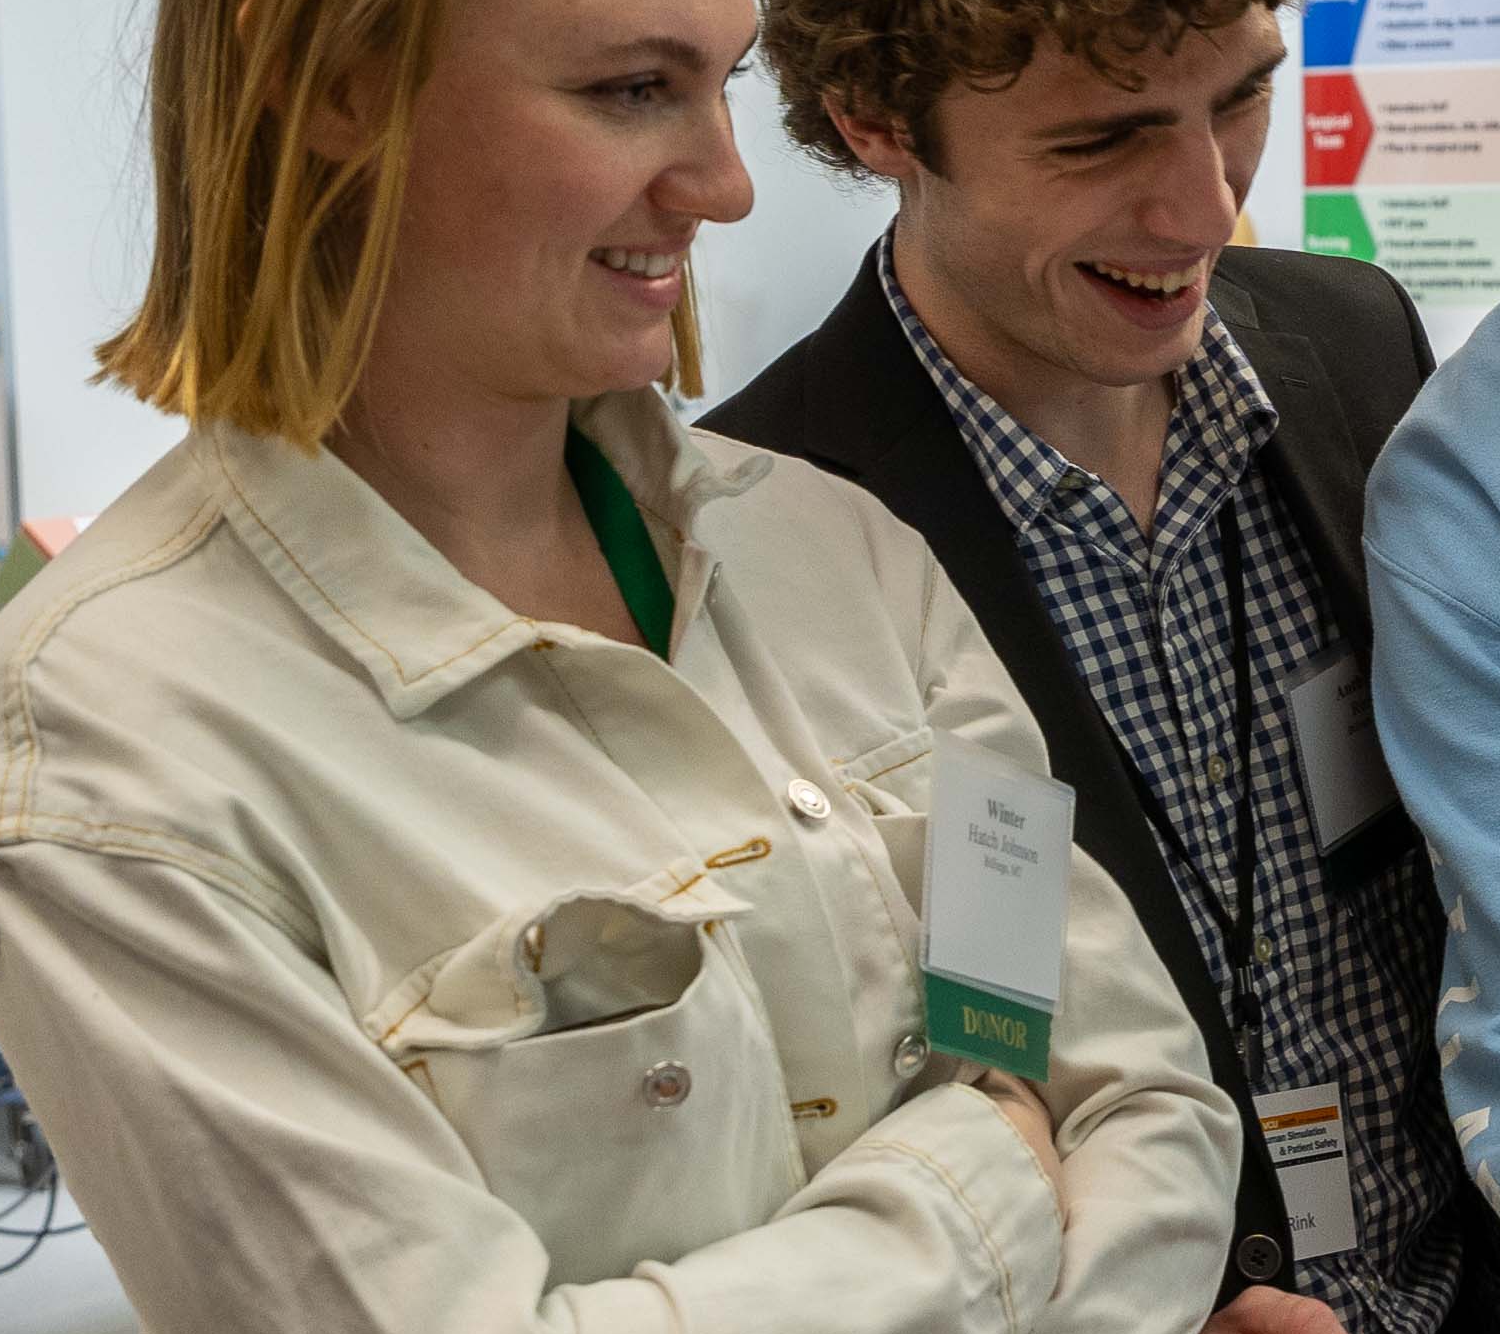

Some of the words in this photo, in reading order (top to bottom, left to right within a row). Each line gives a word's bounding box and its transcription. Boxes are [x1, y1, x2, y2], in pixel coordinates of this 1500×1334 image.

[987, 798, 1026, 829] Winter
[968, 823, 998, 850] Hatch
[1000, 834, 1038, 864] Johnson
[962, 1005, 1028, 1051] DONOR
[1278, 1146, 1287, 1157] &
[1287, 1142, 1314, 1156] Patient
[1314, 1138, 1339, 1151] Safety
[1287, 1126, 1327, 1141] Simulation
